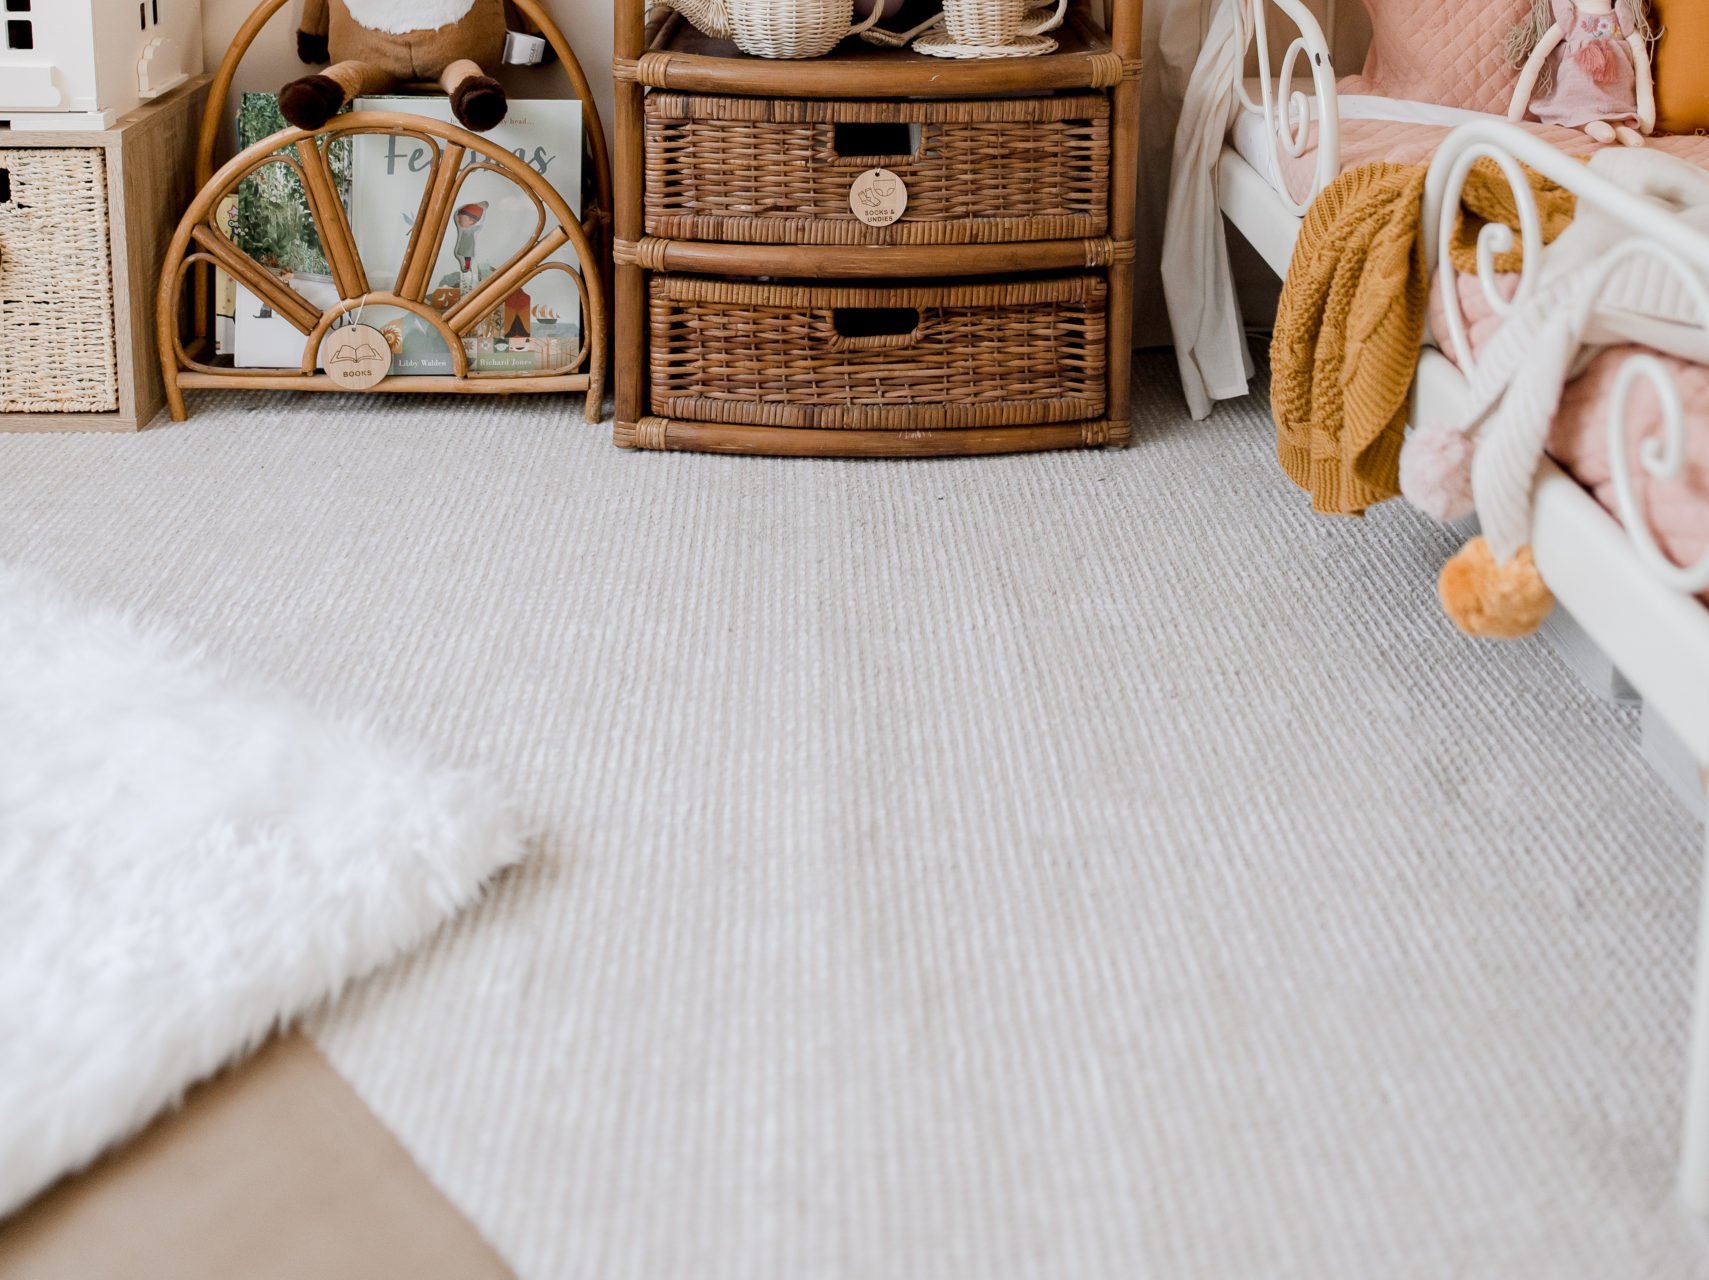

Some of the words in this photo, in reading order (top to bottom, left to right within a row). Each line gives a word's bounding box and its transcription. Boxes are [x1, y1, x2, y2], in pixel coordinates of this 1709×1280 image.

[398, 359, 418, 368] Libby
[421, 359, 447, 367] Walden
[480, 358, 509, 366] Richard
[511, 358, 532, 366] Jones
[342, 369, 373, 378] BOOKS
